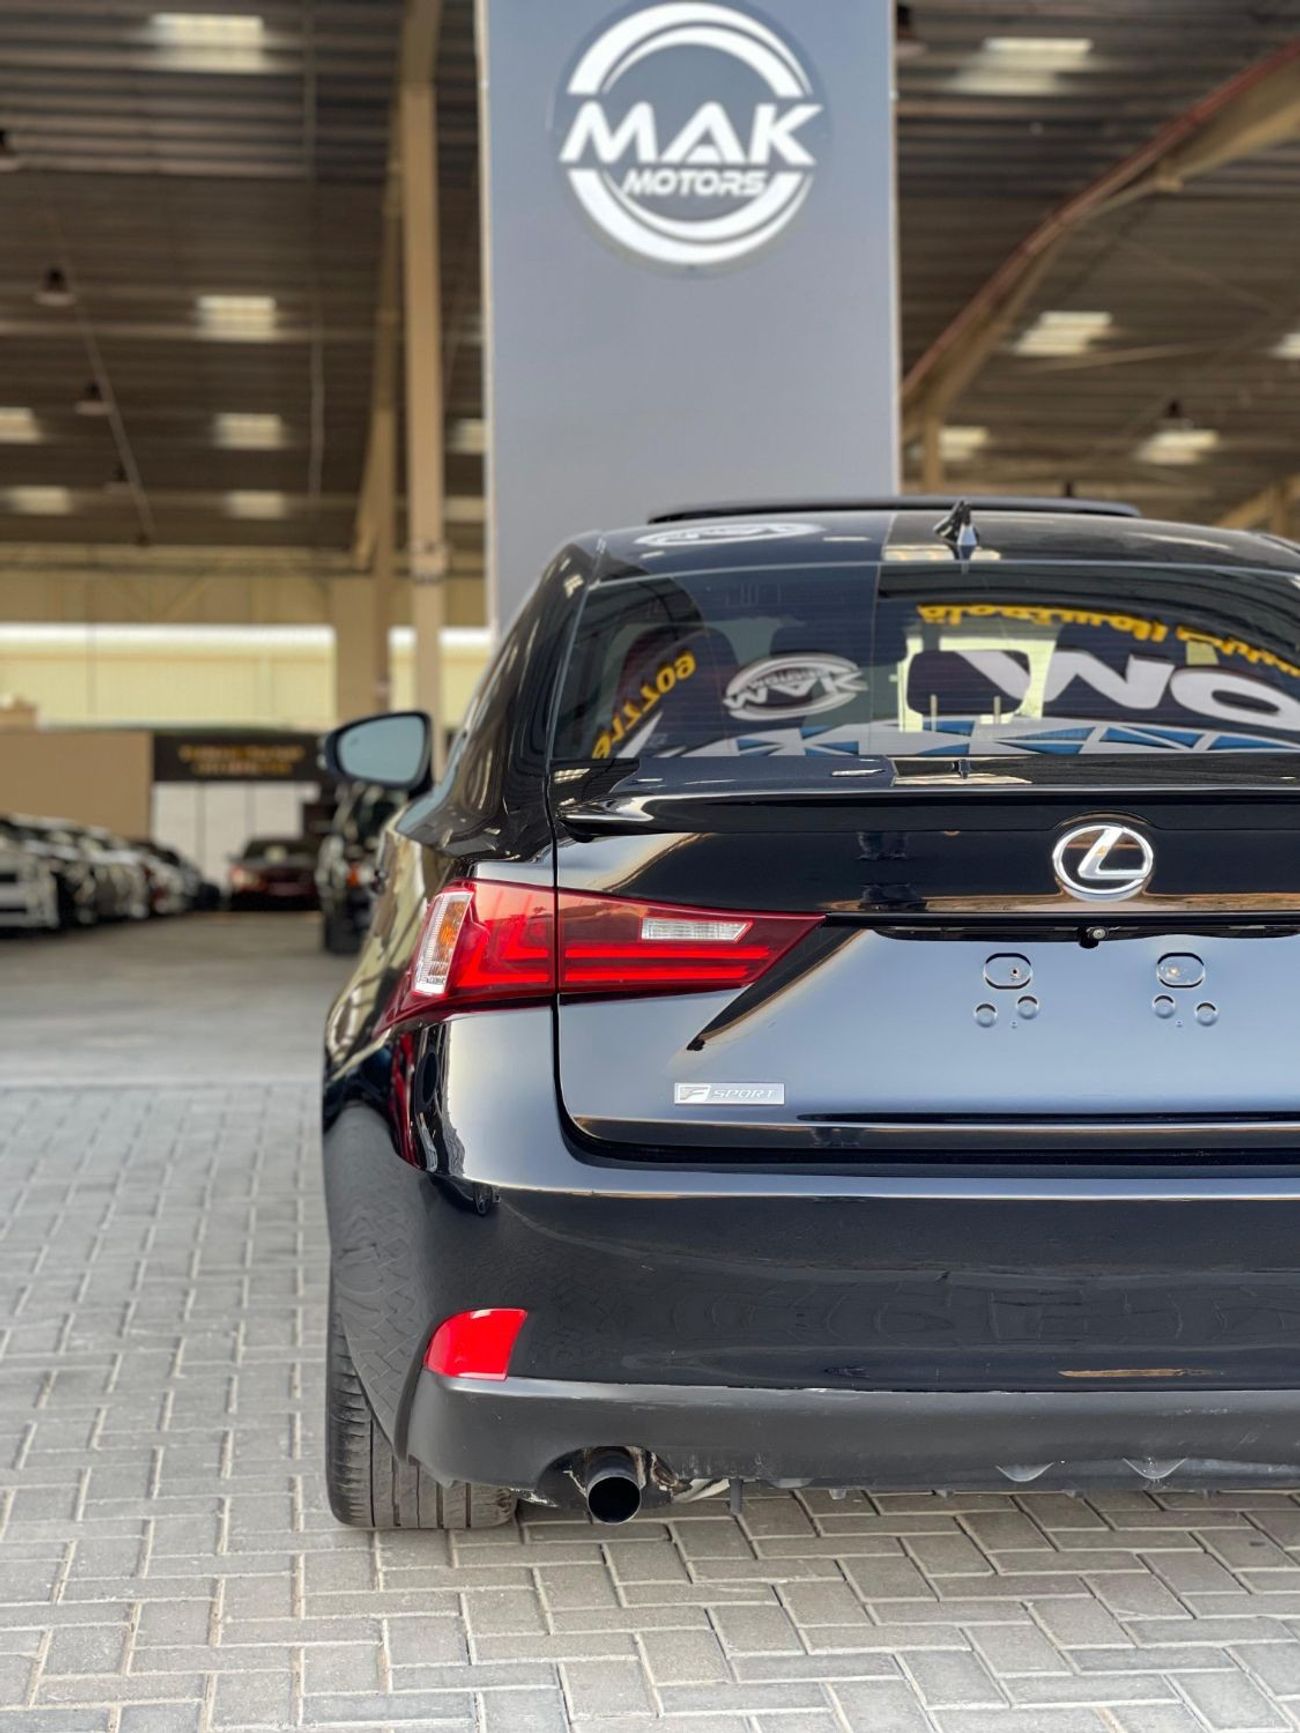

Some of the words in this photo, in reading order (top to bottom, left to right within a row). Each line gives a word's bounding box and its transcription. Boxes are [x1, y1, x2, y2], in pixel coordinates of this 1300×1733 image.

[558, 101, 824, 166] MAK
[622, 168, 768, 198] MOTORS
[712, 1088, 777, 1099] SPORT
